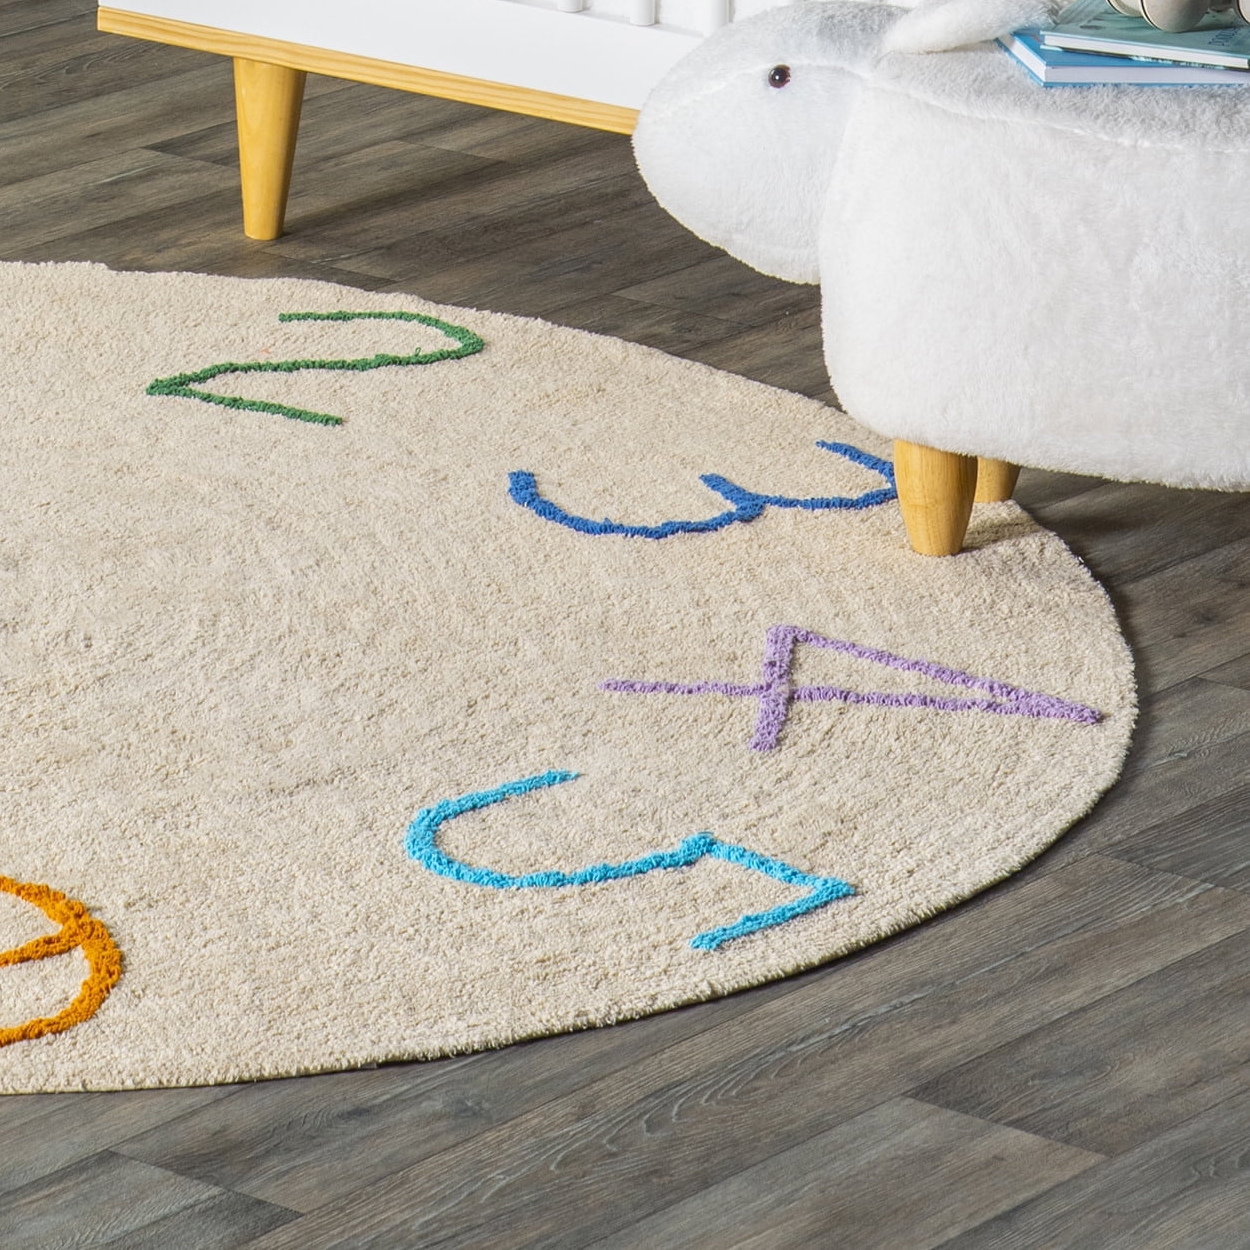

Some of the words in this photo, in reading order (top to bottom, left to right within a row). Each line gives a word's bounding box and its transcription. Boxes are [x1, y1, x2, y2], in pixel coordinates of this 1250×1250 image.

[147, 313, 483, 425] 2
[508, 441, 897, 539] 3
[600, 626, 1102, 751] 4
[405, 770, 856, 951] 5
